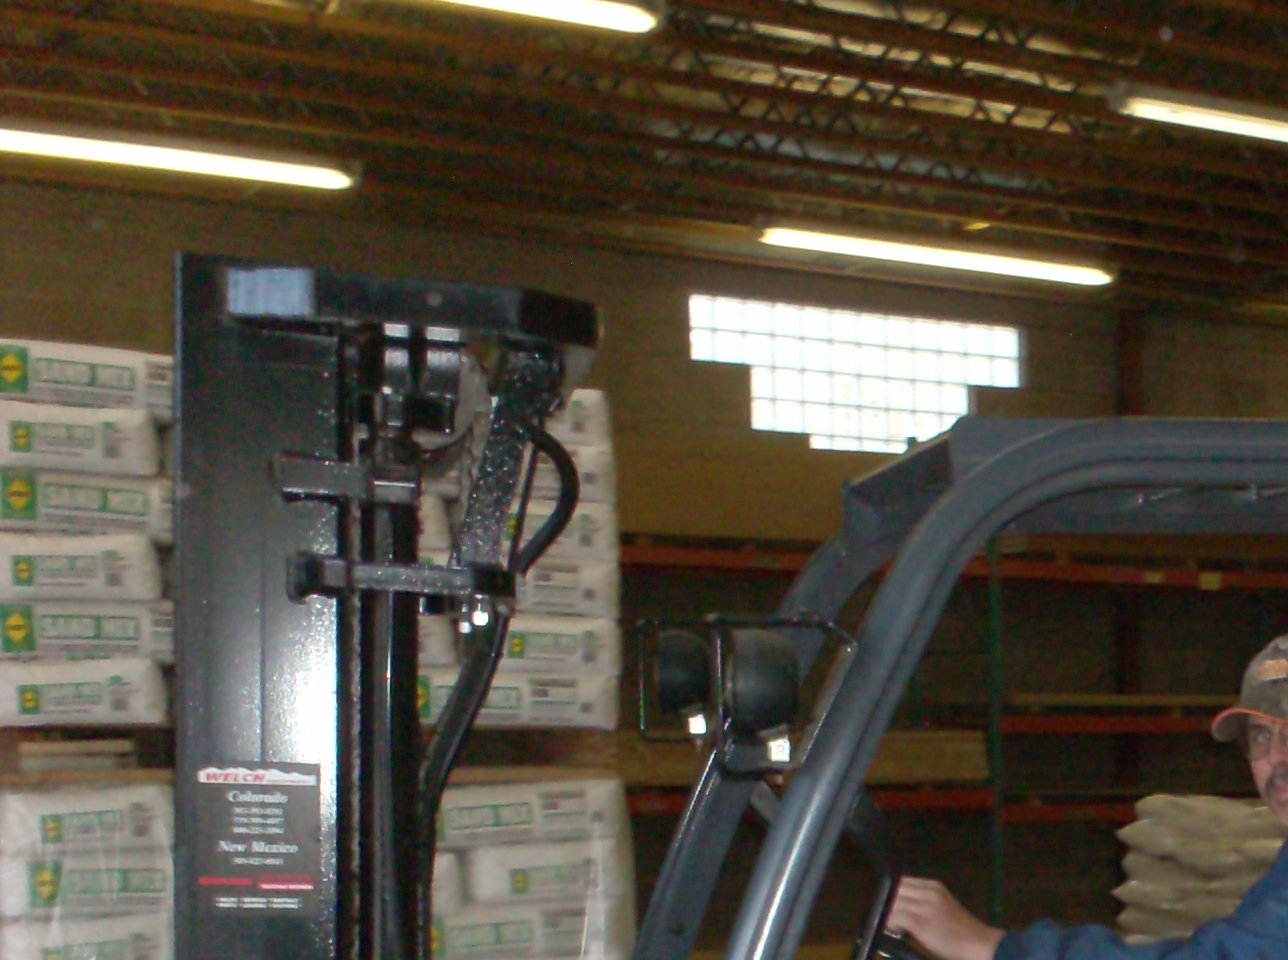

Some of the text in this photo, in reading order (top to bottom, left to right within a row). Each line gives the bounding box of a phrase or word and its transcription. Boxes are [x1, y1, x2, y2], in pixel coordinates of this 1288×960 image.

[206, 772, 265, 783] WELCH
[227, 790, 288, 803] Colorado
[218, 840, 298, 853] New Mexico
